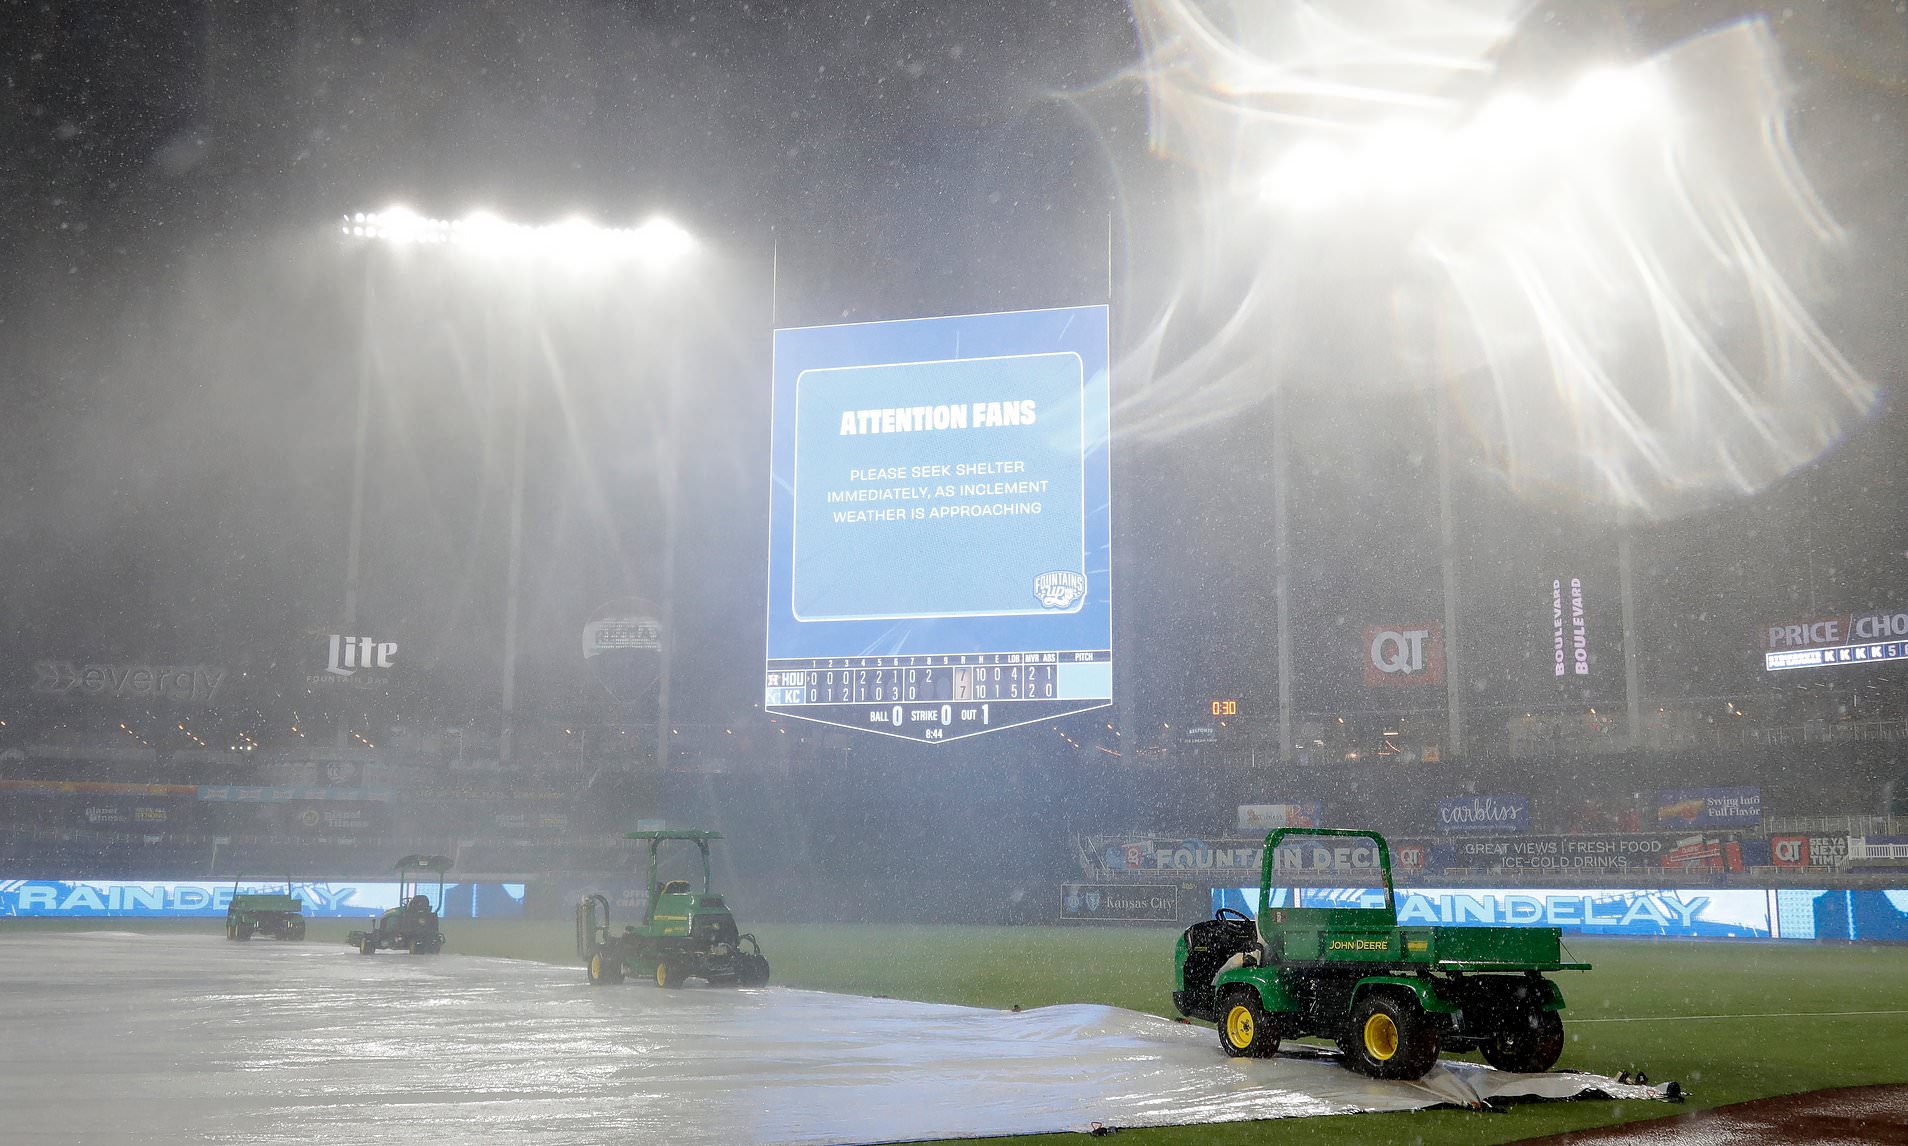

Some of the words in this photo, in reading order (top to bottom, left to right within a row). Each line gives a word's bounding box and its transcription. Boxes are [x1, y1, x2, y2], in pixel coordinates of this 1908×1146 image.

[839, 403, 967, 436] ATTENTION
[972, 399, 1036, 428] FANS
[850, 467, 907, 481] PLEASE
[911, 464, 951, 478] SEEK
[955, 460, 1025, 476] SHELTER
[827, 486, 931, 504] IMMEDIATELY,
[934, 484, 955, 498] AS
[959, 480, 1049, 497] INCLEMENT
[833, 508, 906, 524] WEATHER
[911, 507, 925, 521] IS
[928, 501, 1042, 520] APPROACHING
[1035, 572, 1083, 594] FOUNTAINS
[1553, 579, 1565, 676] BOULEVARD
[1571, 578, 1589, 675] BOULEVARD
[1768, 620, 1839, 648] PRICE
[325, 634, 398, 677] Lite
[828, 660, 833, 668] 2
[844, 659, 849, 667] 3
[861, 659, 866, 667] 4
[877, 658, 882, 666] 5
[893, 658, 898, 666] 6
[910, 657, 914, 666] 7
[926, 657, 931, 665] 8
[943, 656, 948, 665] 9
[961, 656, 966, 664] R
[995, 655, 999, 664] E
[1008, 654, 1020, 663] LOB
[1043, 653, 1056, 662] ABS
[1074, 652, 1094, 662] PITCH
[1371, 630, 1429, 675] QT
[1824, 651, 1835, 662] K
[1840, 649, 1850, 661] K
[1855, 648, 1866, 660] K
[1871, 646, 1882, 658] K
[1888, 645, 1896, 657] 5
[82, 666, 222, 701] evergy
[781, 671, 804, 686] HOU
[811, 671, 817, 685] 0
[827, 671, 833, 685] 0
[843, 671, 849, 684] 0
[860, 670, 866, 684] 2
[876, 670, 882, 684] 2
[909, 669, 915, 683] 0
[925, 669, 931, 683] 2
[960, 668, 966, 681] 7
[976, 668, 986, 681] 10
[994, 667, 1000, 681] 0
[1011, 667, 1017, 681] 4
[1028, 666, 1035, 680] 2
[1046, 666, 1050, 680] 1
[784, 689, 800, 703] KC
[811, 688, 816, 702] 0
[843, 687, 849, 701] 2
[876, 687, 881, 701] 0
[892, 686, 898, 700] 3
[909, 686, 915, 700] 0
[960, 686, 966, 699] 7
[976, 685, 986, 698] 10
[1011, 684, 1017, 698] 5
[1028, 684, 1035, 697] 2
[1046, 683, 1052, 697] 0
[870, 711, 889, 722] BALL
[892, 705, 903, 727] 0
[911, 710, 938, 721] STRIKE
[941, 704, 952, 726] 0
[961, 709, 977, 721] OUT
[982, 703, 989, 725] 1
[1212, 701, 1236, 715] 0:30
[926, 728, 943, 739] 8:44
[1440, 798, 1522, 824] carbliss
[1729, 805, 1761, 816] Flavor
[1466, 843, 1510, 855] GREAT
[1513, 842, 1557, 855] VIEWS
[1568, 842, 1615, 853] FRESH
[1620, 840, 1662, 853] FOOD
[1776, 841, 1802, 862] QT
[1809, 838, 1829, 846] SEE
[1831, 838, 1846, 846] YA
[1810, 846, 1846, 856] NEXT
[1401, 849, 1418, 866] QT
[1502, 856, 1570, 868] ICE-COLD
[1573, 855, 1628, 867] DRINKS
[19, 886, 164, 910] RAIN
[1106, 896, 1147, 910] Kansas
[1150, 896, 1174, 913] City
[1503, 894, 1710, 928] DELAY
[1329, 940, 1355, 951] JOHN
[1356, 940, 1388, 951] DEERE
